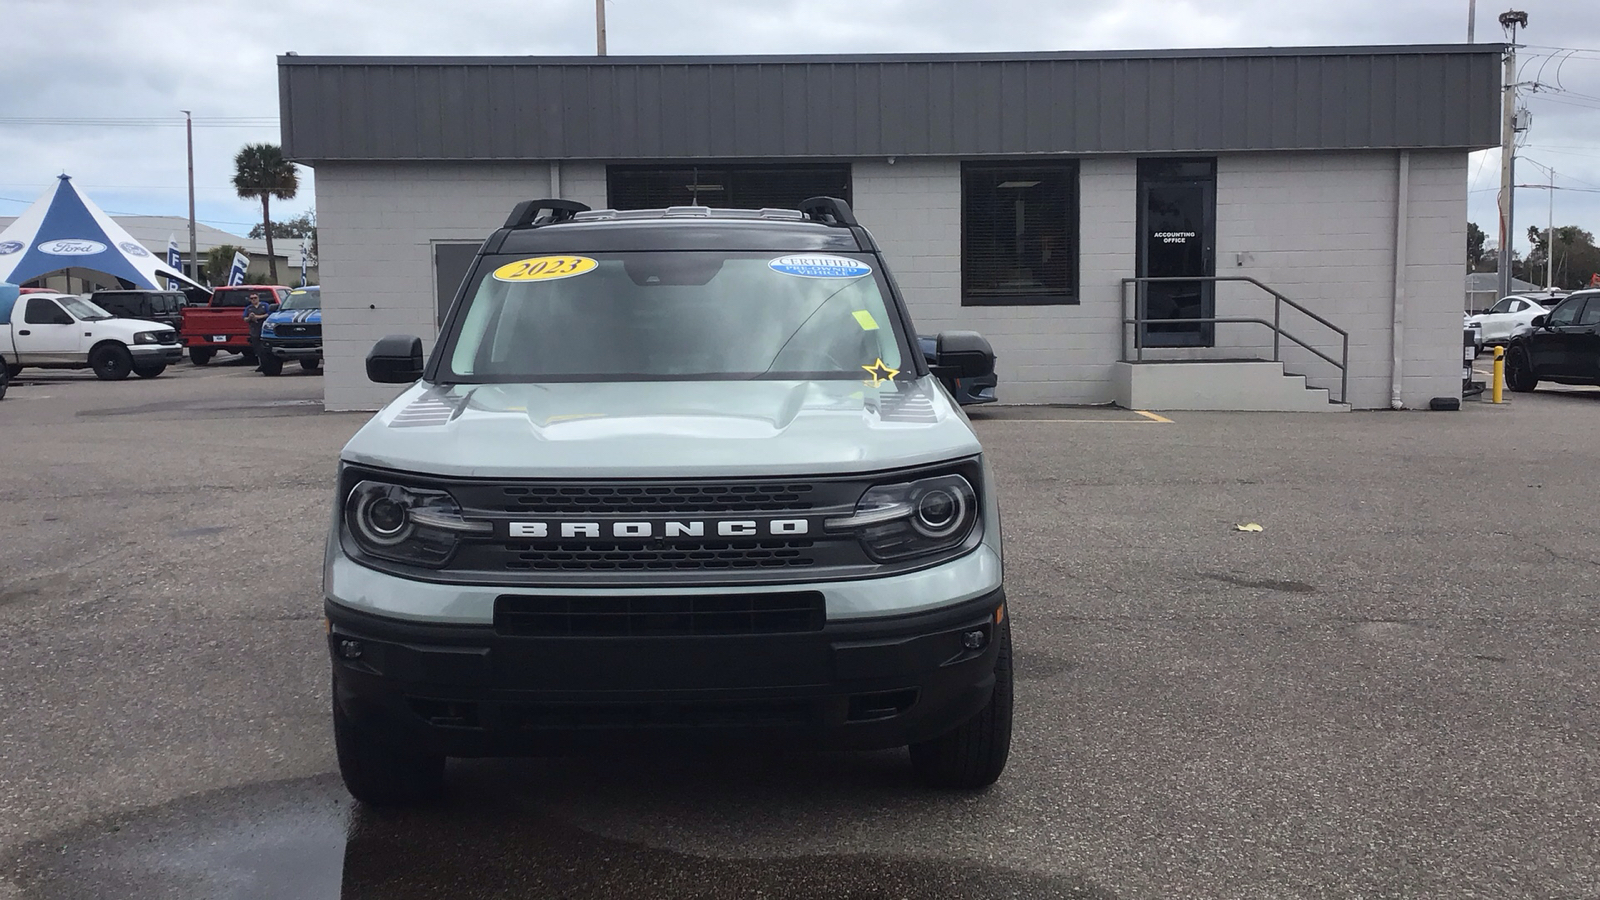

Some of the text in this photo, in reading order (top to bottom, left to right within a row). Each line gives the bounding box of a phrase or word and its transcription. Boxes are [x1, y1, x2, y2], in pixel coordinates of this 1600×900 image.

[52, 242, 93, 253] Ford
[509, 259, 582, 278] 2023
[779, 258, 858, 267] CERTIFIED
[509, 519, 808, 537] BRONCO
